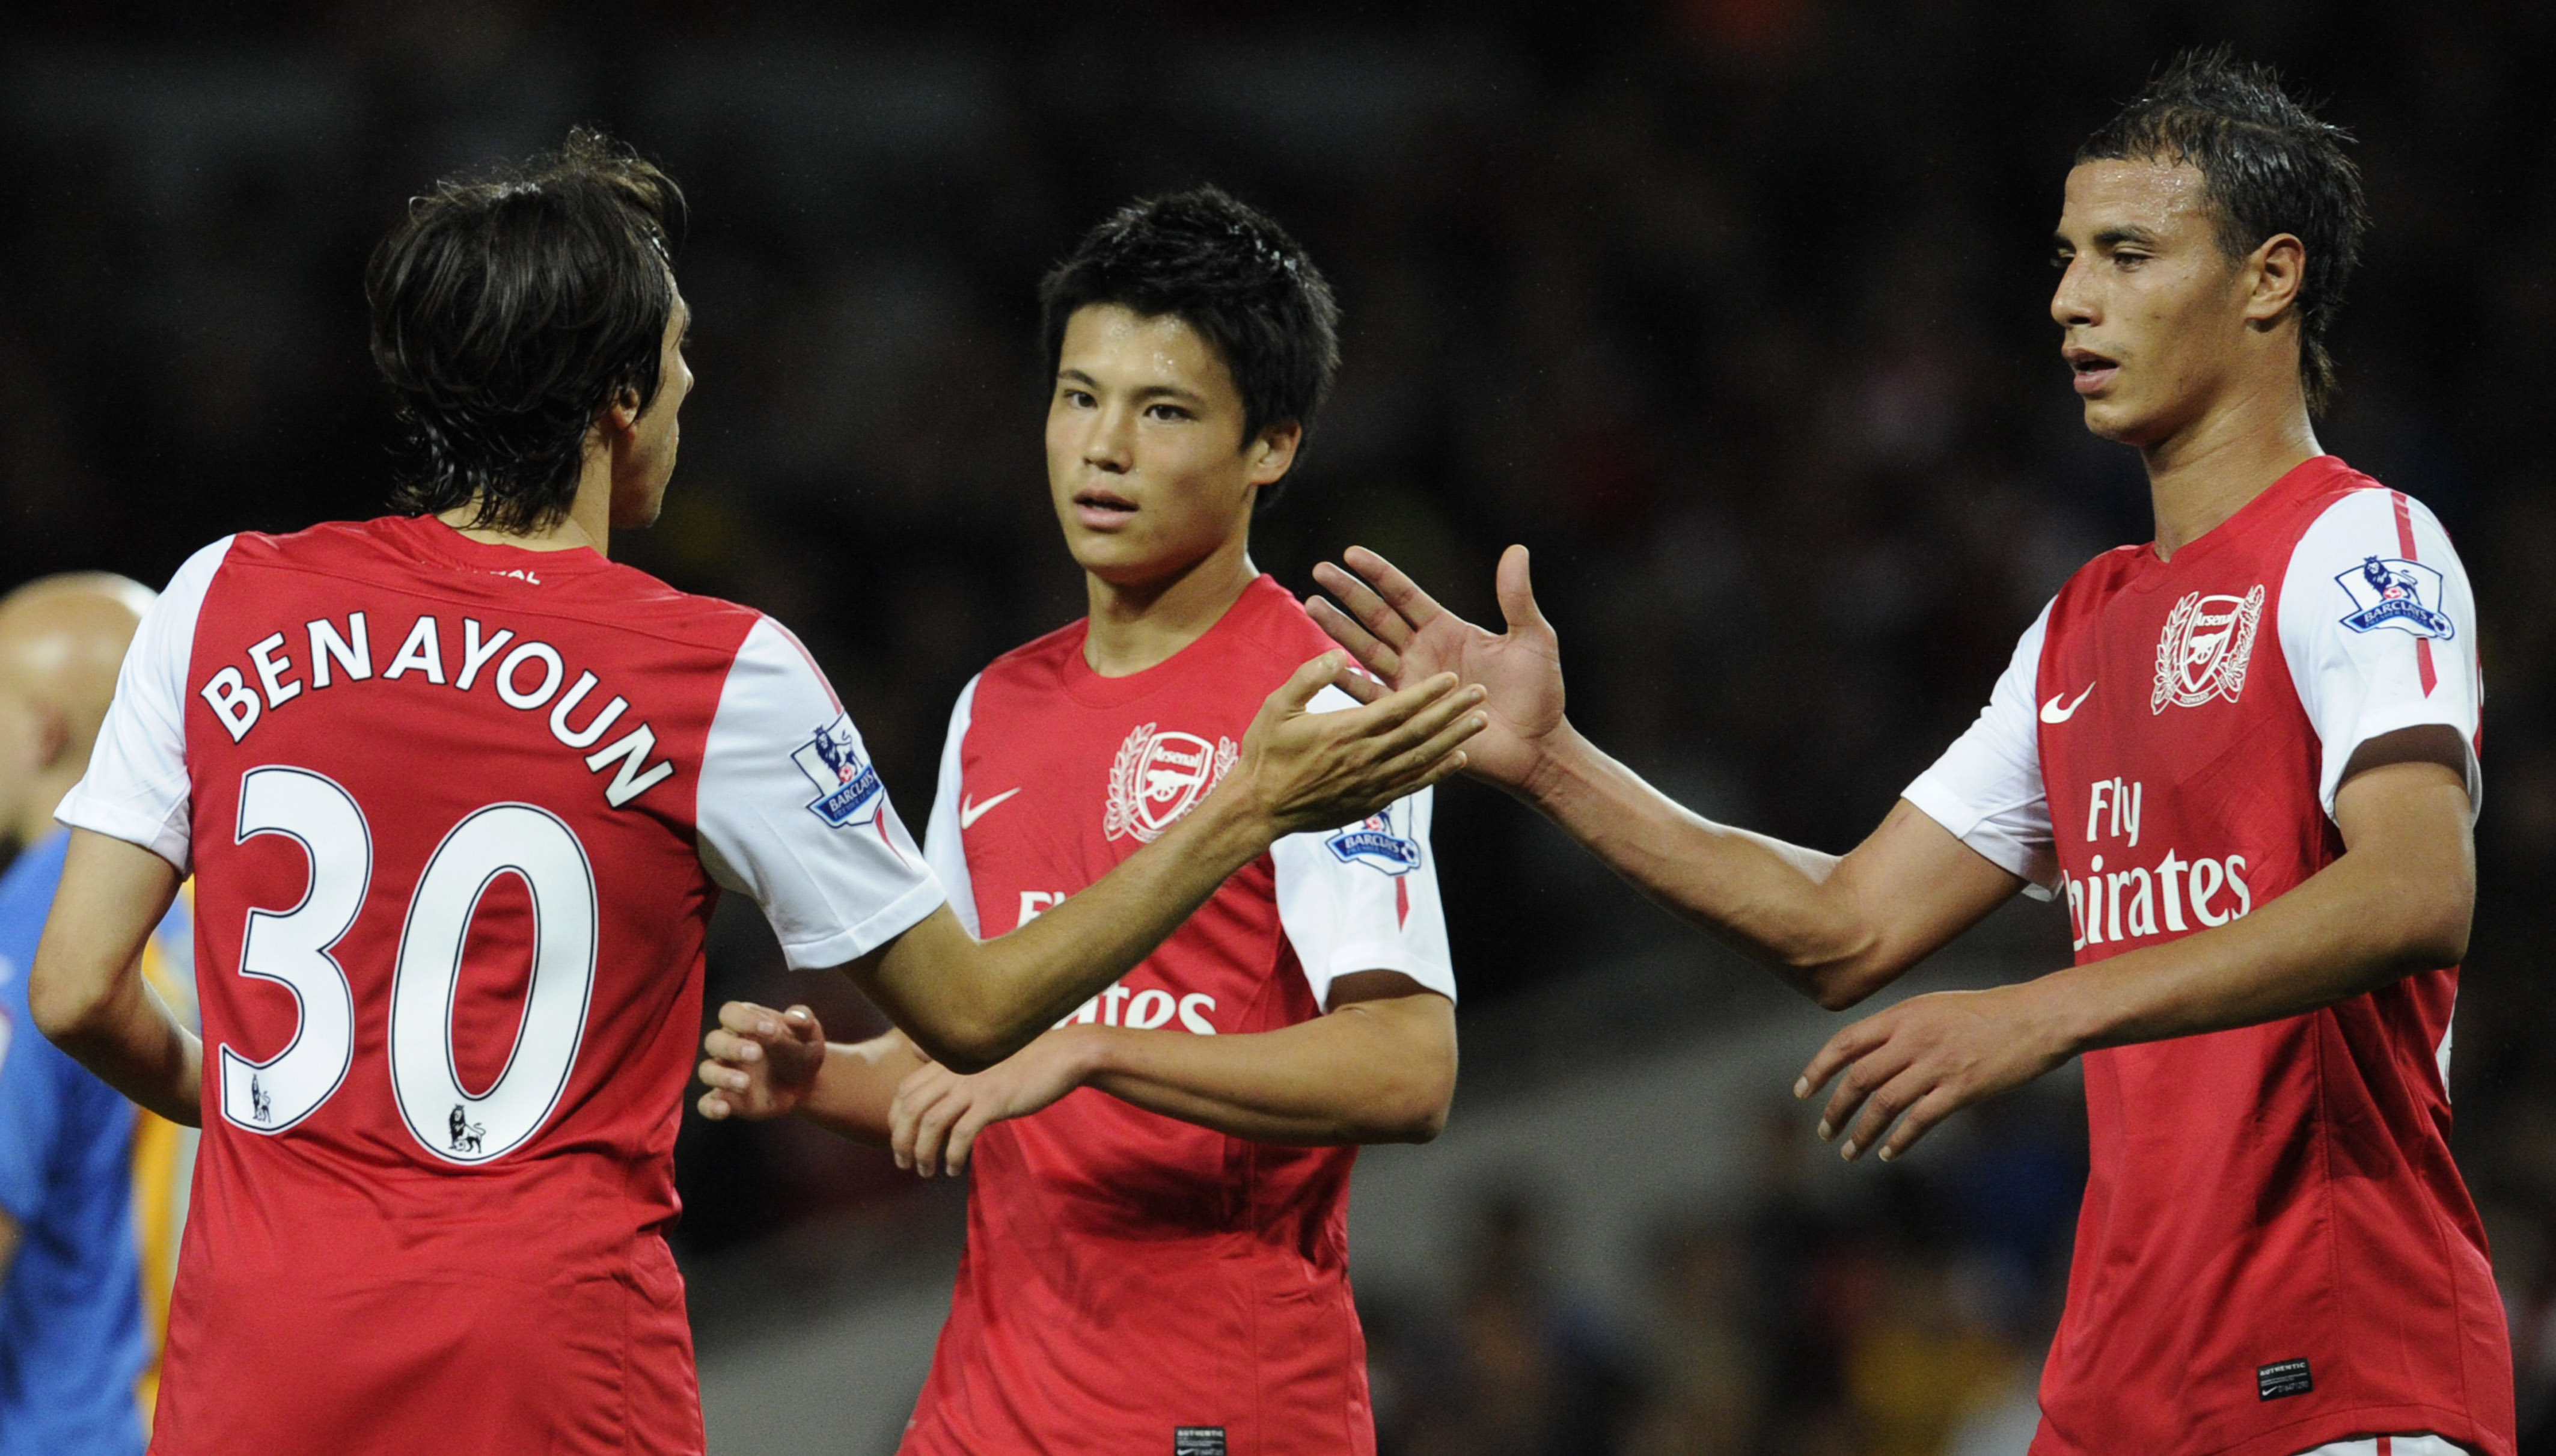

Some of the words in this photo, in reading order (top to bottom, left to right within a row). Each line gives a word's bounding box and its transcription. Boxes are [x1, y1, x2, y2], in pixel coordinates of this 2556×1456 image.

[2364, 601, 2427, 623] BARCLAYS
[200, 611, 674, 809] BENAYOUN
[828, 769, 874, 812] BARCLAYS
[2087, 776, 2142, 848] Fly
[1345, 834, 1399, 853] BARCLAYS
[219, 764, 599, 1166] 30
